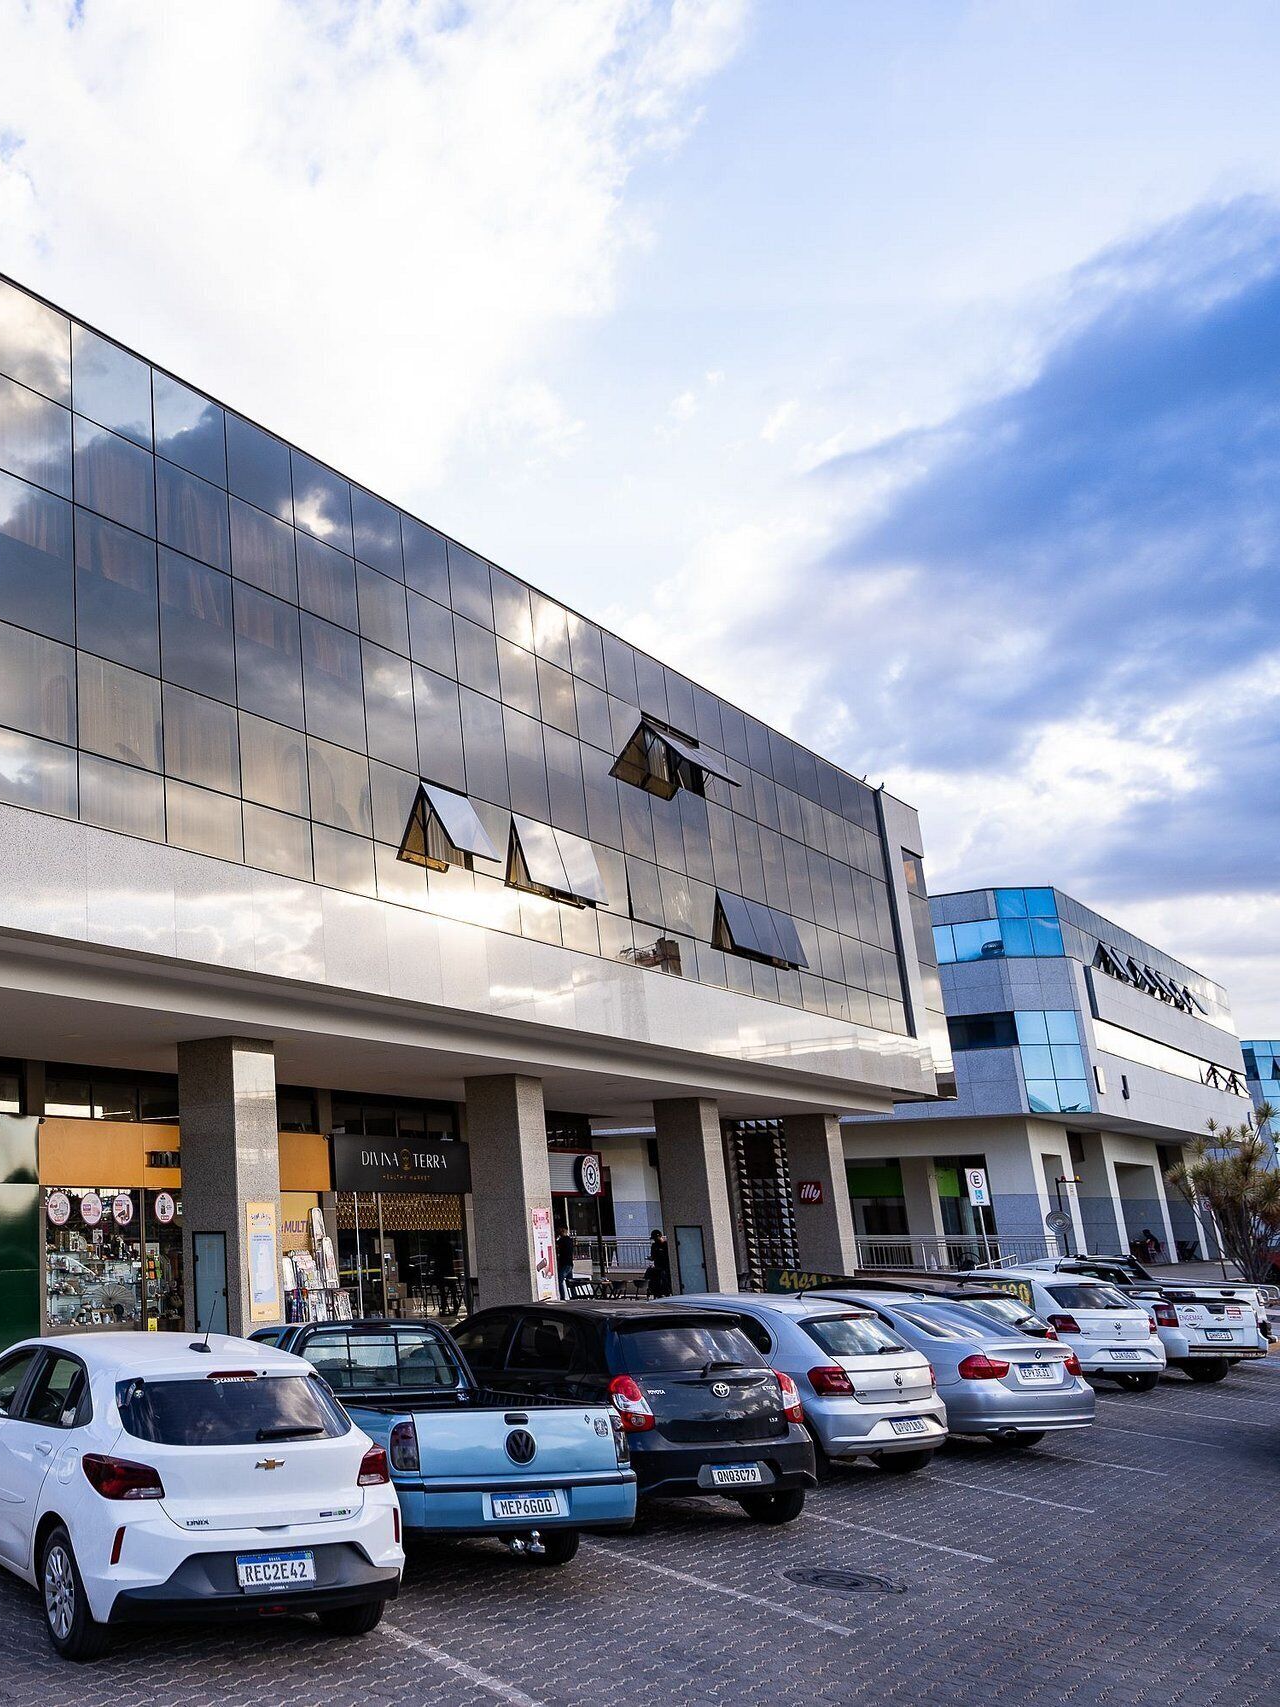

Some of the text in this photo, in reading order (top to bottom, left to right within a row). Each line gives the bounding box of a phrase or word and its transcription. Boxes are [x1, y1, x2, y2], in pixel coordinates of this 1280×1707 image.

[361, 1150, 448, 1169] DIVINA TERRA
[801, 1184, 820, 1201] illy
[245, 1562, 308, 1583] REC2E42
